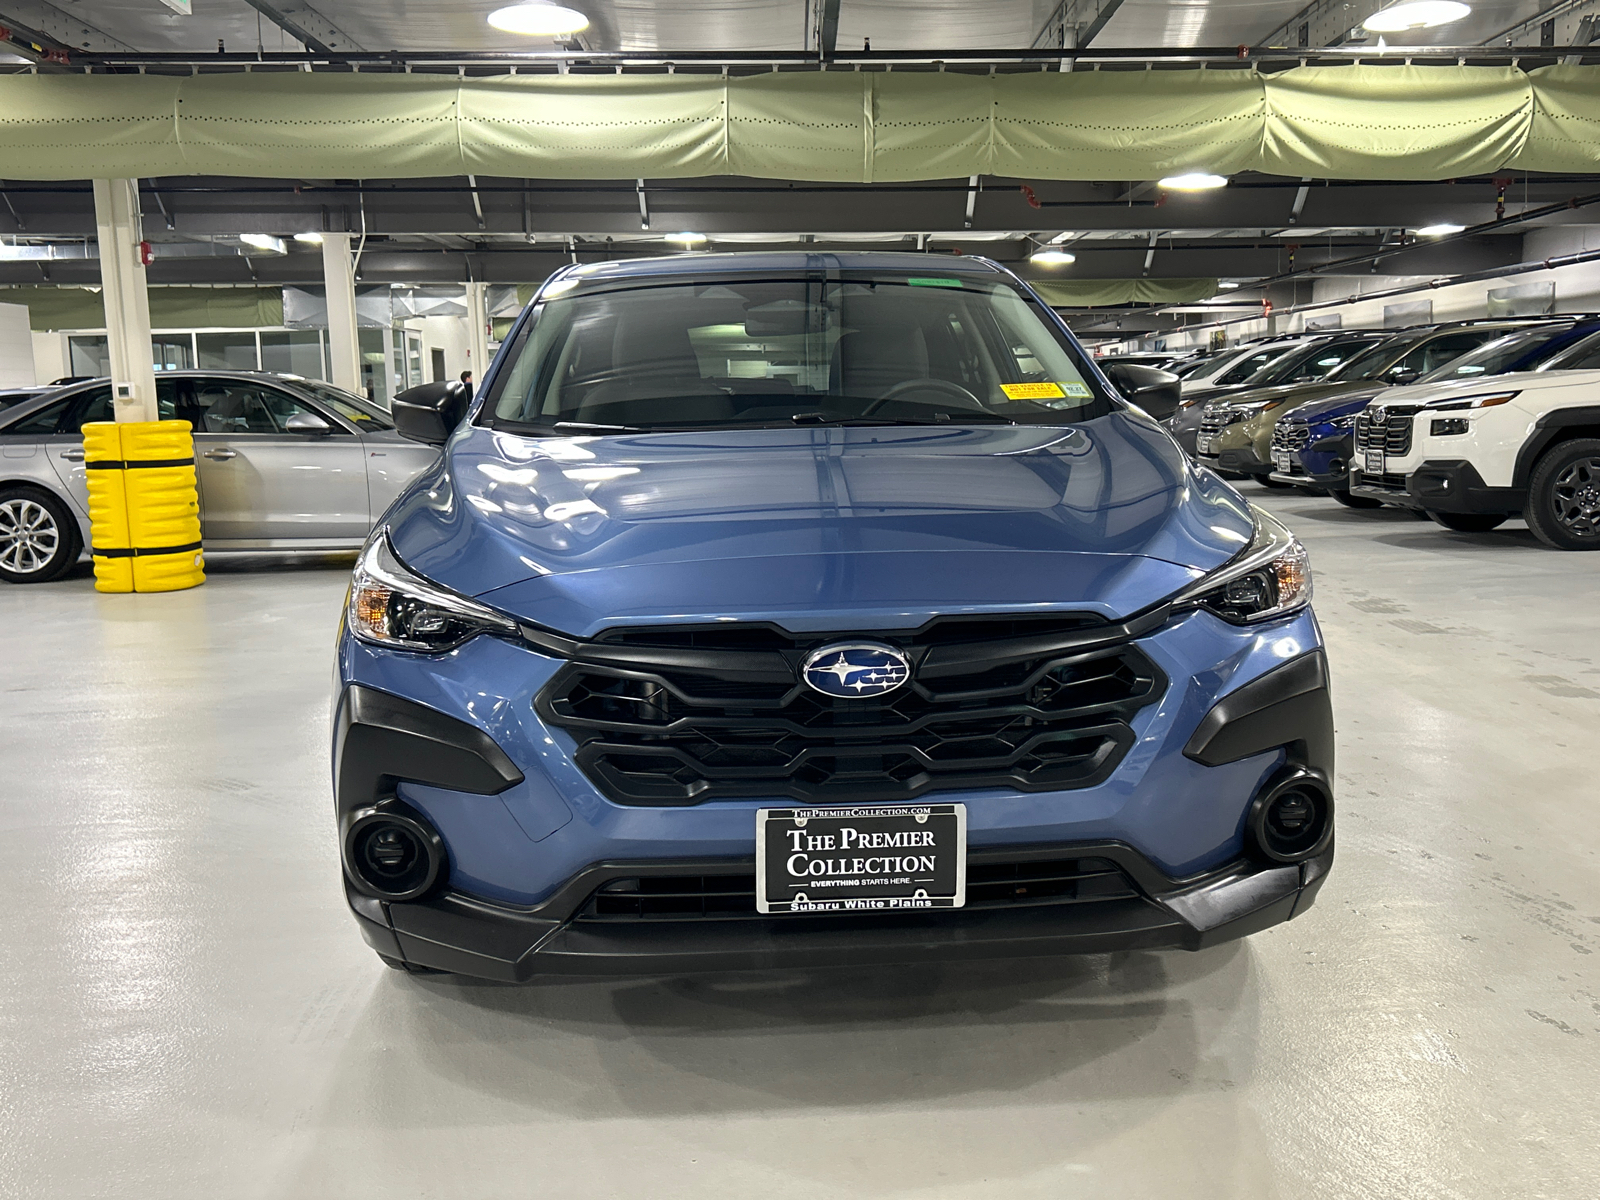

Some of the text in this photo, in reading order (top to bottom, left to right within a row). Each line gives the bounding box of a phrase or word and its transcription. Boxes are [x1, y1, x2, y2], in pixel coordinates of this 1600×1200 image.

[786, 827, 937, 851] THE PREMIER
[786, 854, 936, 877] COLLECTION
[811, 877, 912, 888] EVERYTHING STARTS HERE.
[790, 898, 932, 912] Subaru White Plains
